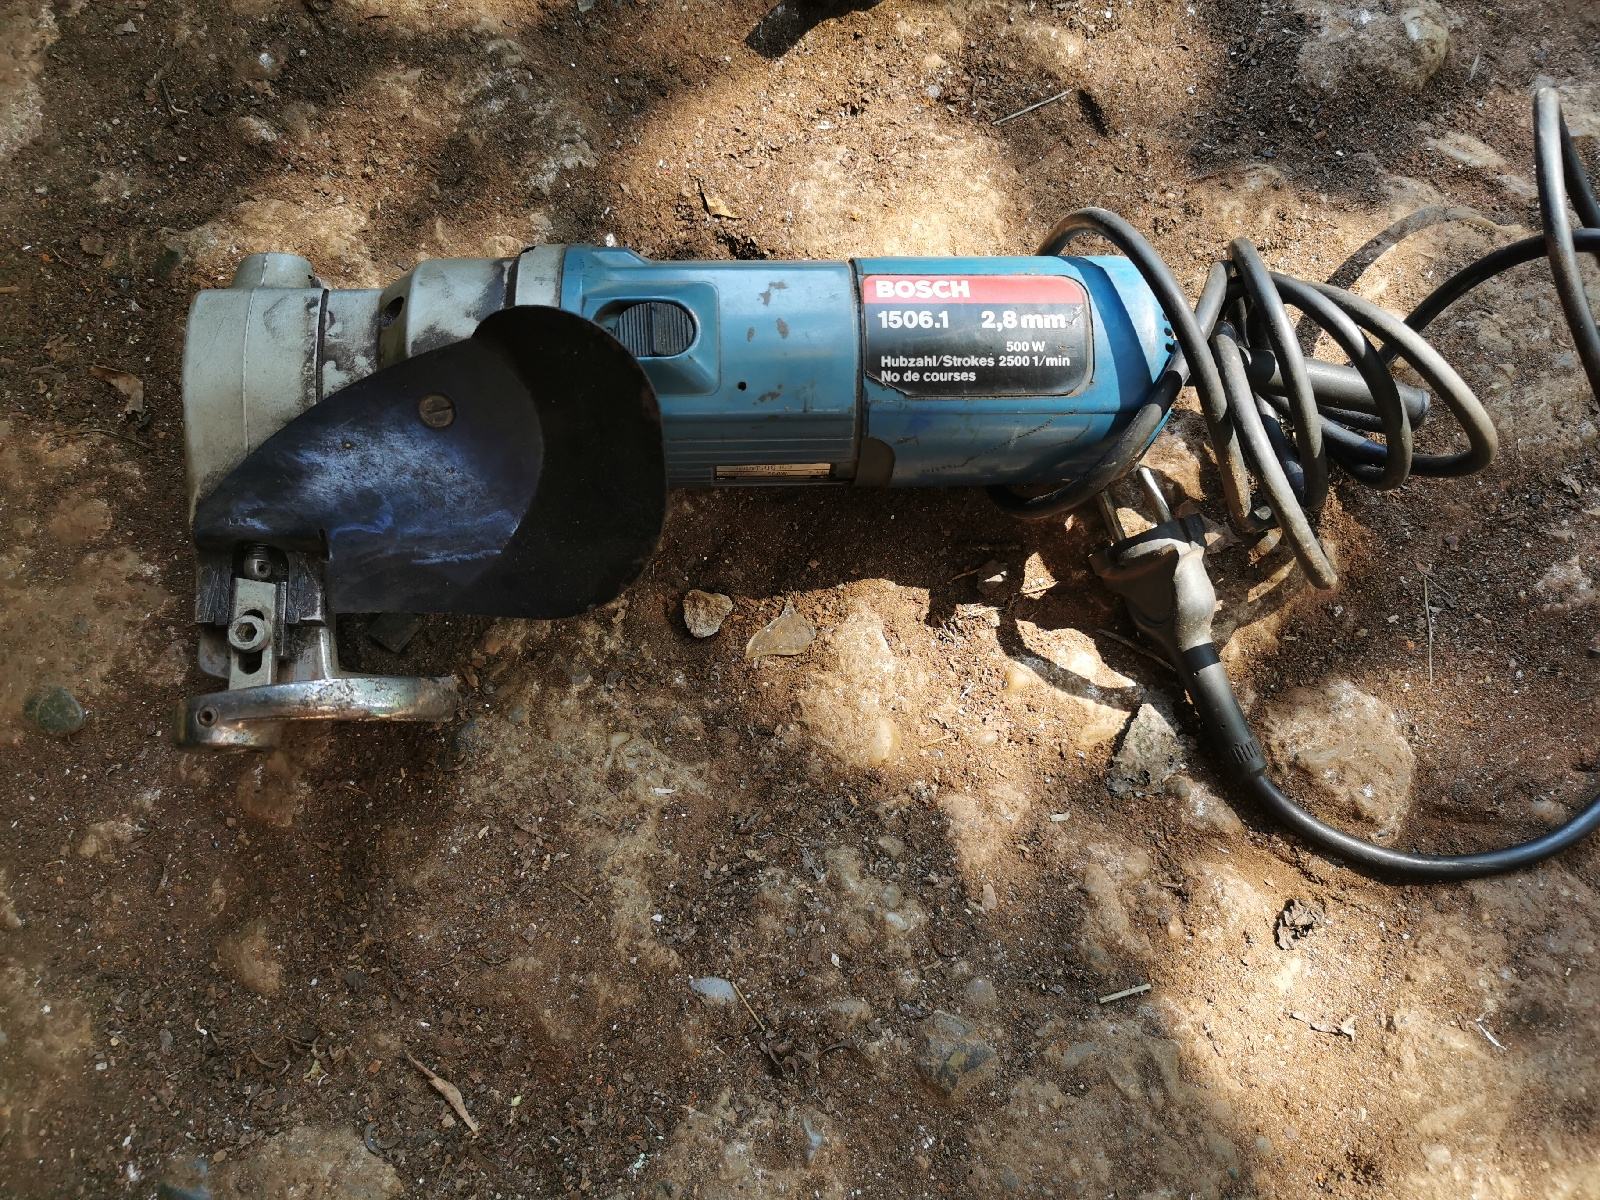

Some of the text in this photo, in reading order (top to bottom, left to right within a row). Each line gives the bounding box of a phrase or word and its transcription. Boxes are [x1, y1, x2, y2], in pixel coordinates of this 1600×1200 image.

[875, 280, 971, 298] BOSCH
[877, 310, 1066, 332] 1506.1 2,8 mm
[1006, 341, 1046, 352] 500 W
[880, 355, 1071, 368] Hubzahl/Strokes 2500 1/min
[880, 370, 977, 382] No de courses
